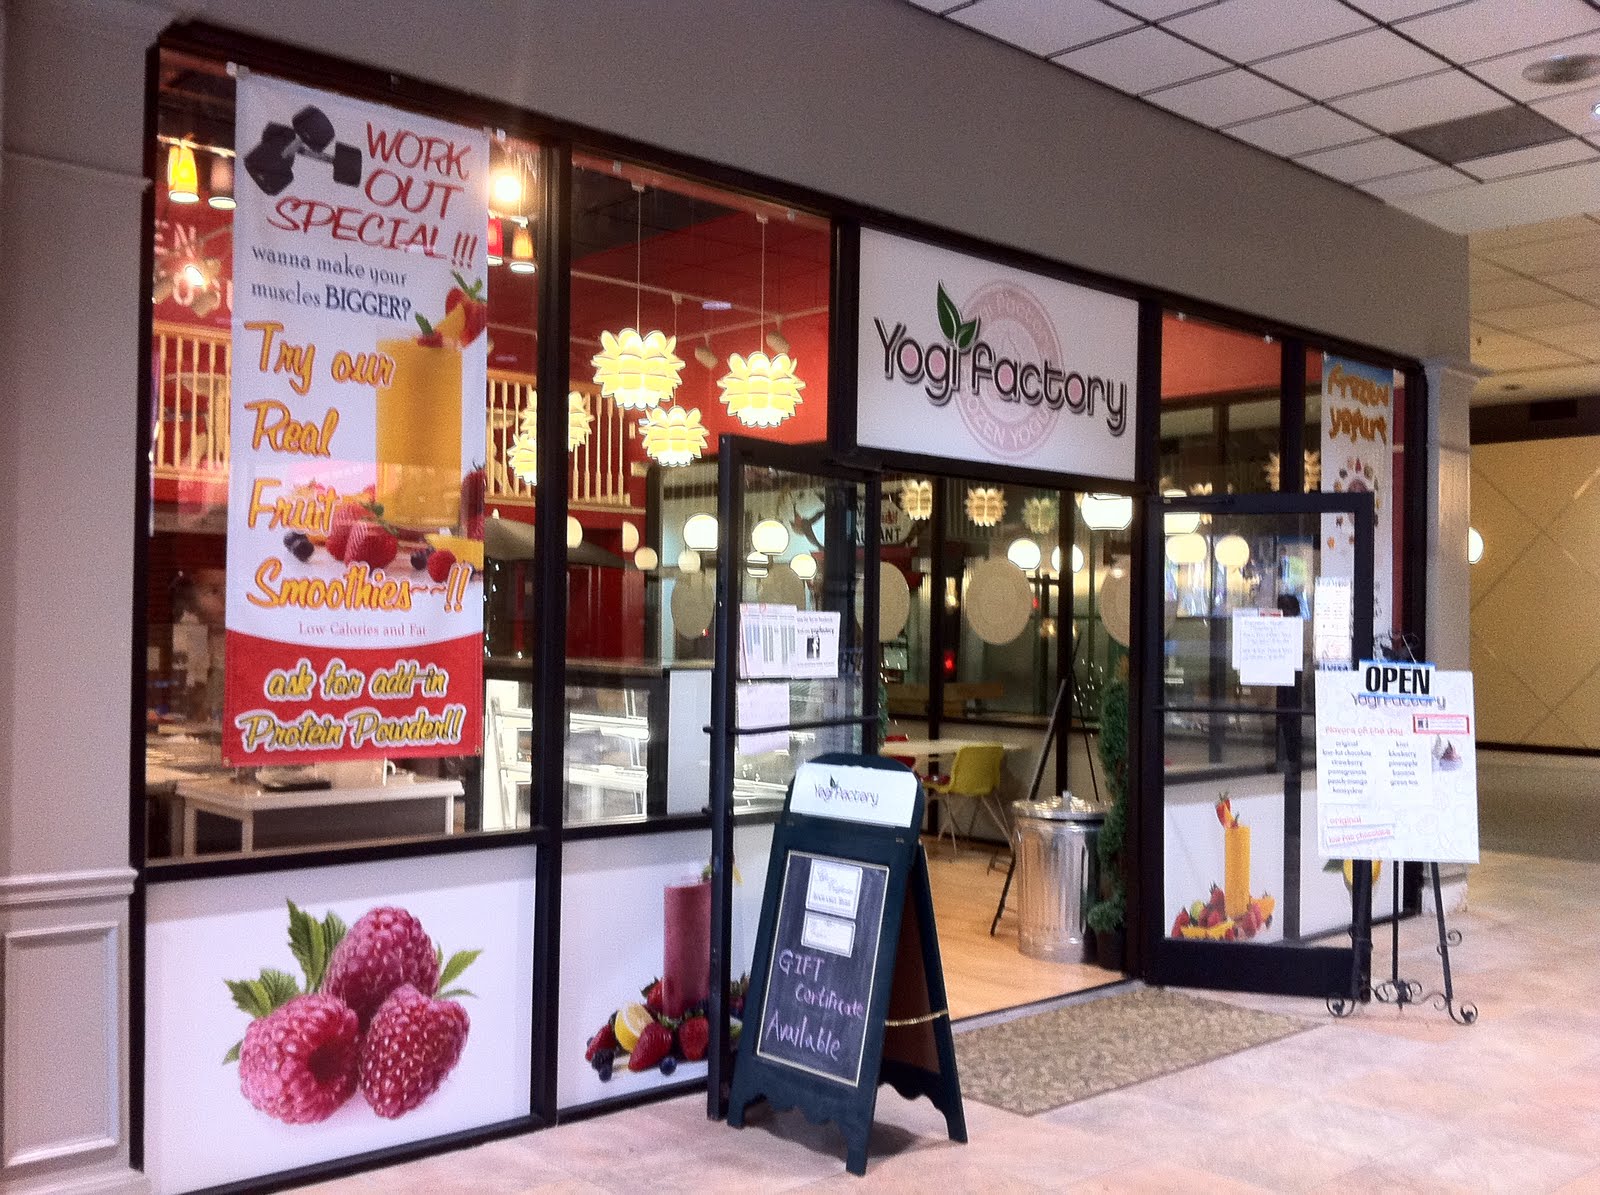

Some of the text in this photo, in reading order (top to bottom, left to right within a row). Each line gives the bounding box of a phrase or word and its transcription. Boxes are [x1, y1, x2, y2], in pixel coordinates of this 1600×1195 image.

[366, 121, 471, 180] WORK
[364, 168, 464, 219] OUT
[252, 246, 408, 287] wanna make your
[252, 283, 321, 308] muscles
[325, 285, 411, 322] BIGGER?
[244, 321, 396, 396] Try our
[244, 399, 339, 458] Real
[248, 477, 337, 533] Fruit
[299, 622, 427, 636] Low Calories and Fat
[266, 660, 448, 698] ask for add-in
[1365, 666, 1430, 695] OPEN
[238, 709, 345, 750] Protein
[778, 950, 825, 982] GIFT
[766, 1010, 841, 1062] Available
